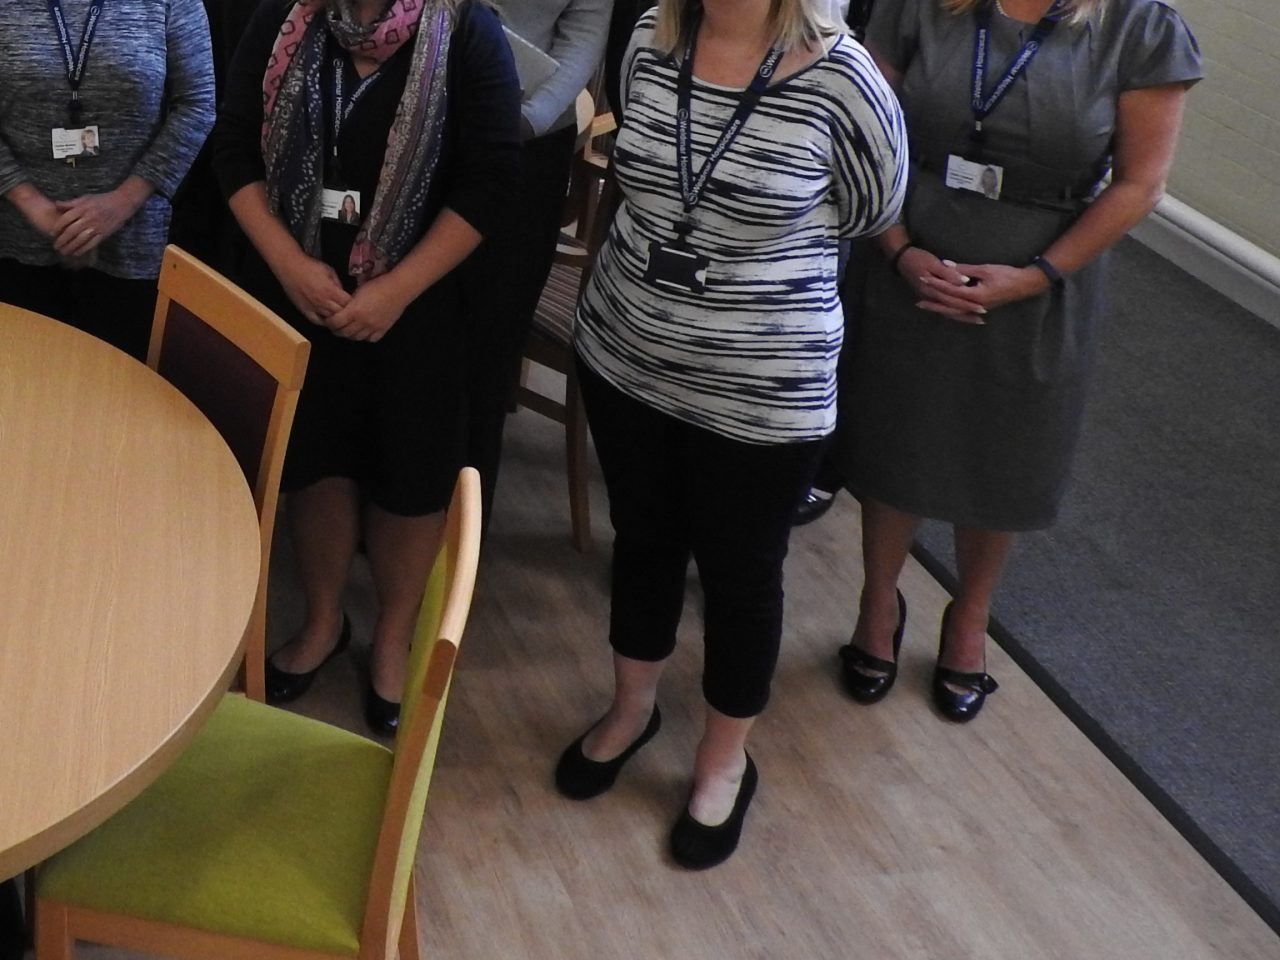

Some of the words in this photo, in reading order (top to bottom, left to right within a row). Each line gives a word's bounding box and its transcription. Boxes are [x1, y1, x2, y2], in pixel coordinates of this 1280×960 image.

[50, 5, 69, 43] Hospicecare
[677, 119, 689, 154] Weldmar
[690, 161, 714, 195] Weldmar
[708, 116, 741, 164] Hospicecare
